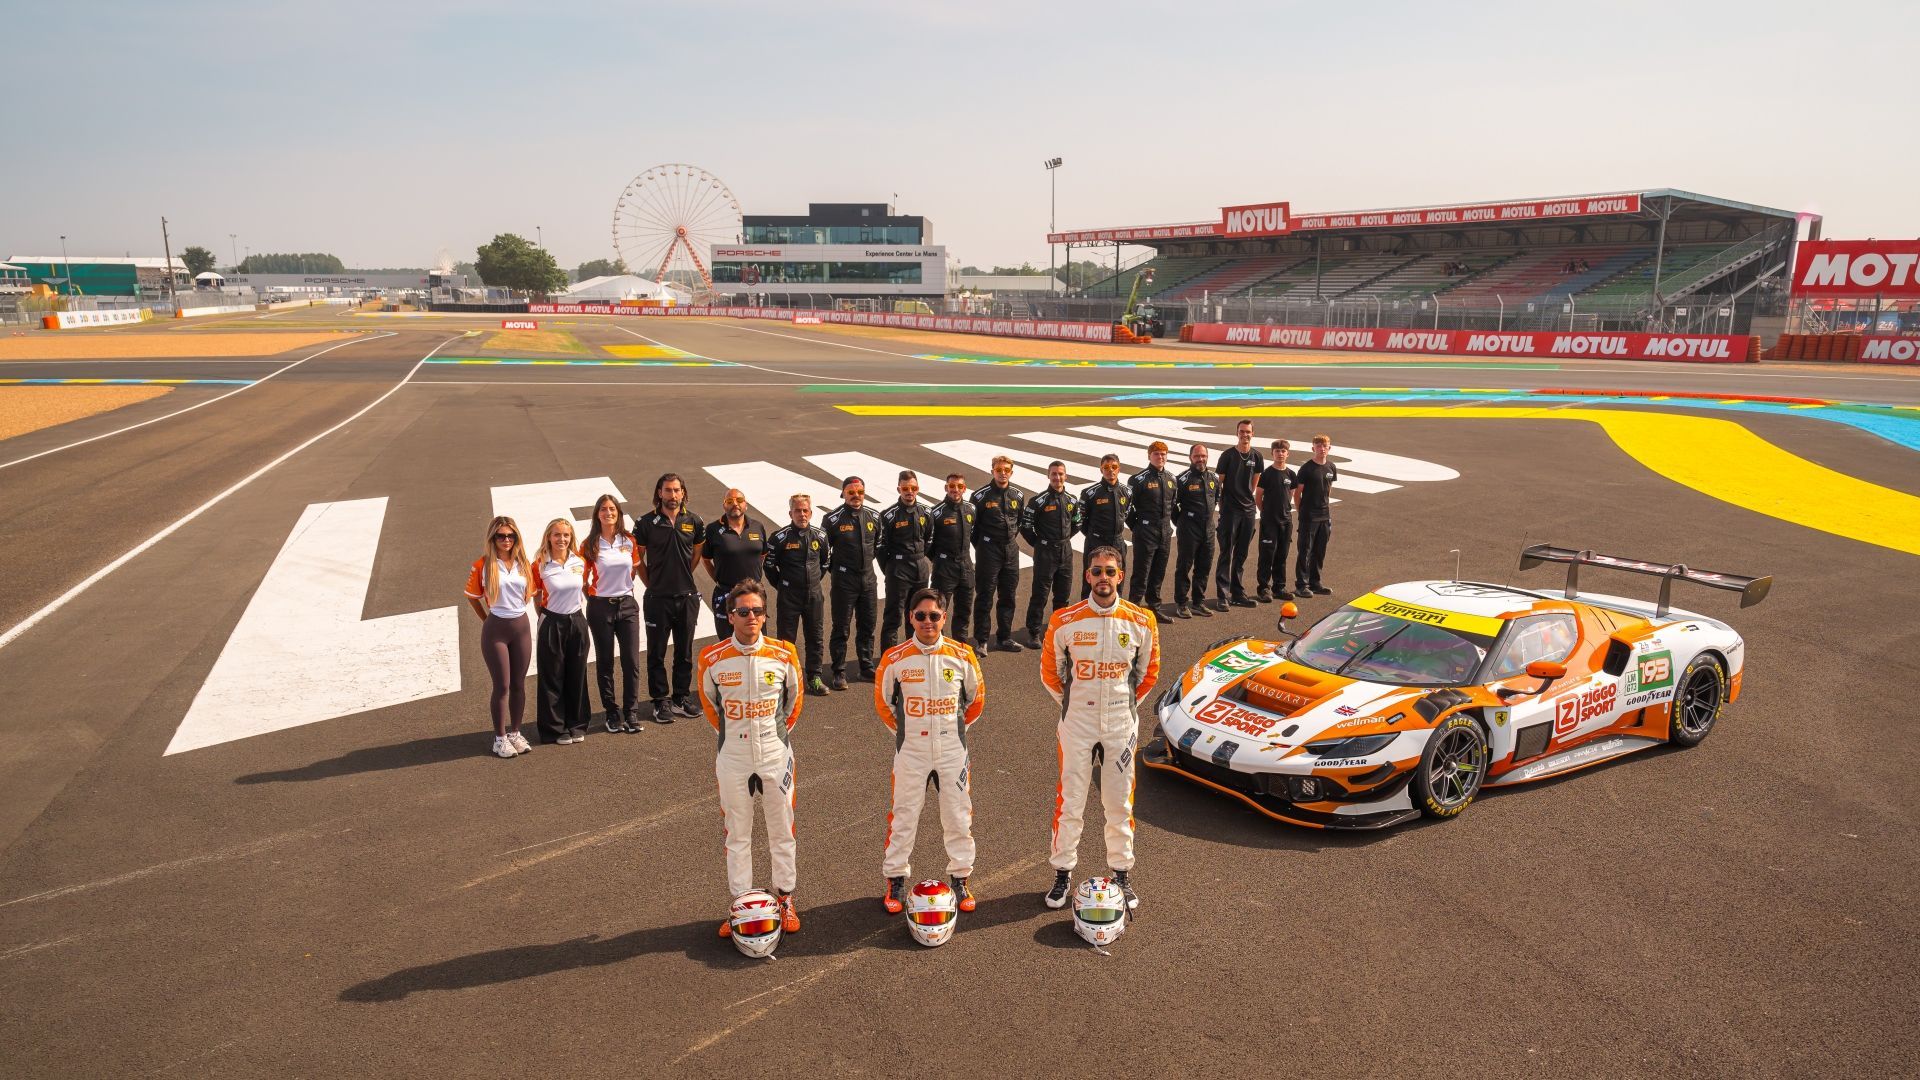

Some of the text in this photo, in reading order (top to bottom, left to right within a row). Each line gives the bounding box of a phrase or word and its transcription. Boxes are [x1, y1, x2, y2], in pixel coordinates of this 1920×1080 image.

[1227, 208, 1286, 233] MOTUL
[1302, 199, 1628, 228] MOTUL MOTUL MOTUL MOTUL MOTUL MOTUL MOTUL MOTUL MOTUL
[1116, 231, 1131, 239] MOTUL
[1134, 230, 1150, 238] MOTUL
[1153, 228, 1170, 237] MOTUL
[1174, 227, 1192, 236] MOTUL
[1195, 226, 1214, 234] MOTUL
[1802, 253, 1920, 286] MOT
[530, 305, 554, 313] MOTUL
[558, 305, 582, 313] MOTUL
[585, 305, 610, 314] MOTUL
[613, 306, 639, 314] MOTUL
[642, 307, 665, 315] MOTUL
[668, 307, 688, 315] MOTUL
[690, 307, 708, 315] MOTUL
[710, 308, 726, 316] MOTUL
[972, 320, 991, 331] MOTUL
[992, 321, 1012, 333] MOTUL
[1014, 323, 1035, 334] MOTUL
[1037, 324, 1058, 336] MOTUL
[1060, 325, 1084, 337] MOTUL
[1086, 326, 1111, 339] MOTUL
[1226, 328, 1730, 357] MOTUL MOTUL MOTUL MOTUL MOTUL MOTUL MOTUL
[1374, 602, 1448, 624] Ferrari
[1098, 662, 1128, 671] ZIGGO
[1098, 670, 1126, 679] SPORT
[1640, 657, 1670, 685] 193
[927, 698, 956, 707] ZIGGO
[1246, 681, 1309, 705] VANGUART
[1582, 683, 1616, 707] ZIGGO
[1627, 690, 1671, 705] GOODYEAR
[745, 699, 776, 710] ZIGGO
[746, 707, 775, 719] SPORT
[927, 706, 956, 715] SPORT
[1581, 698, 1616, 722] SPORT
[1221, 717, 1267, 737] SPORT
[1231, 708, 1276, 728] ZIGGO
[1337, 716, 1385, 728] wellman
[1448, 718, 1473, 730] EAGLE
[1314, 759, 1367, 767] GOODYEAR
